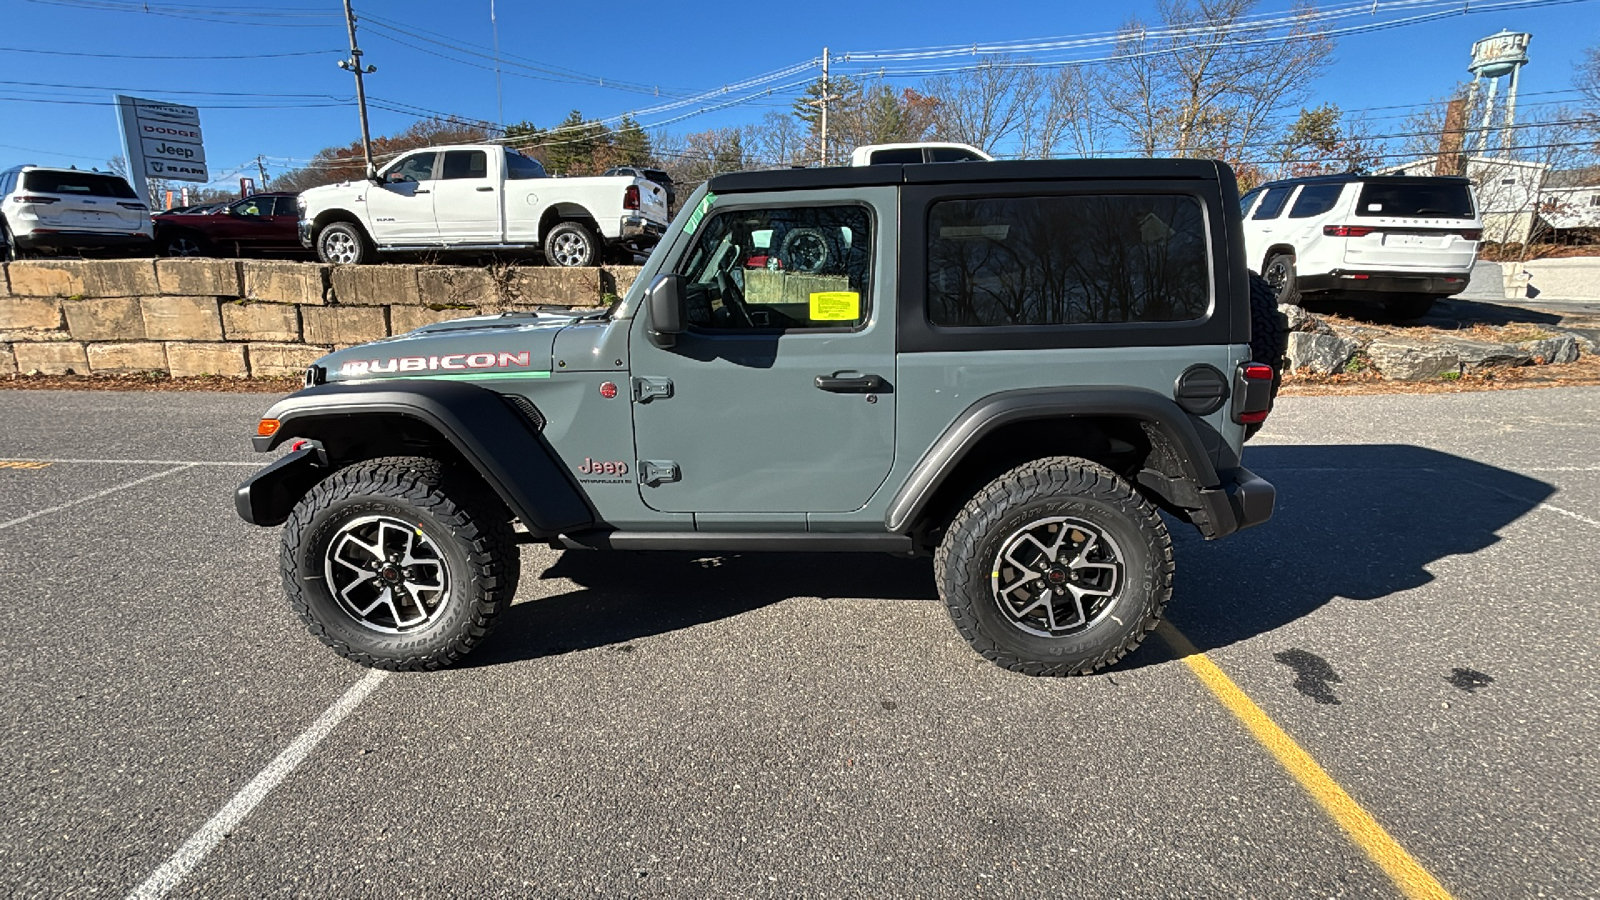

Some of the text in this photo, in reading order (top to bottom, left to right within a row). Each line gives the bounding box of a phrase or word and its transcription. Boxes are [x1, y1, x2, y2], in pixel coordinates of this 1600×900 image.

[144, 126, 198, 138] DODGE
[156, 143, 194, 158] Jeep
[167, 166, 204, 175] RAM
[341, 351, 531, 376] RUBICON
[578, 457, 629, 477] Jeep
